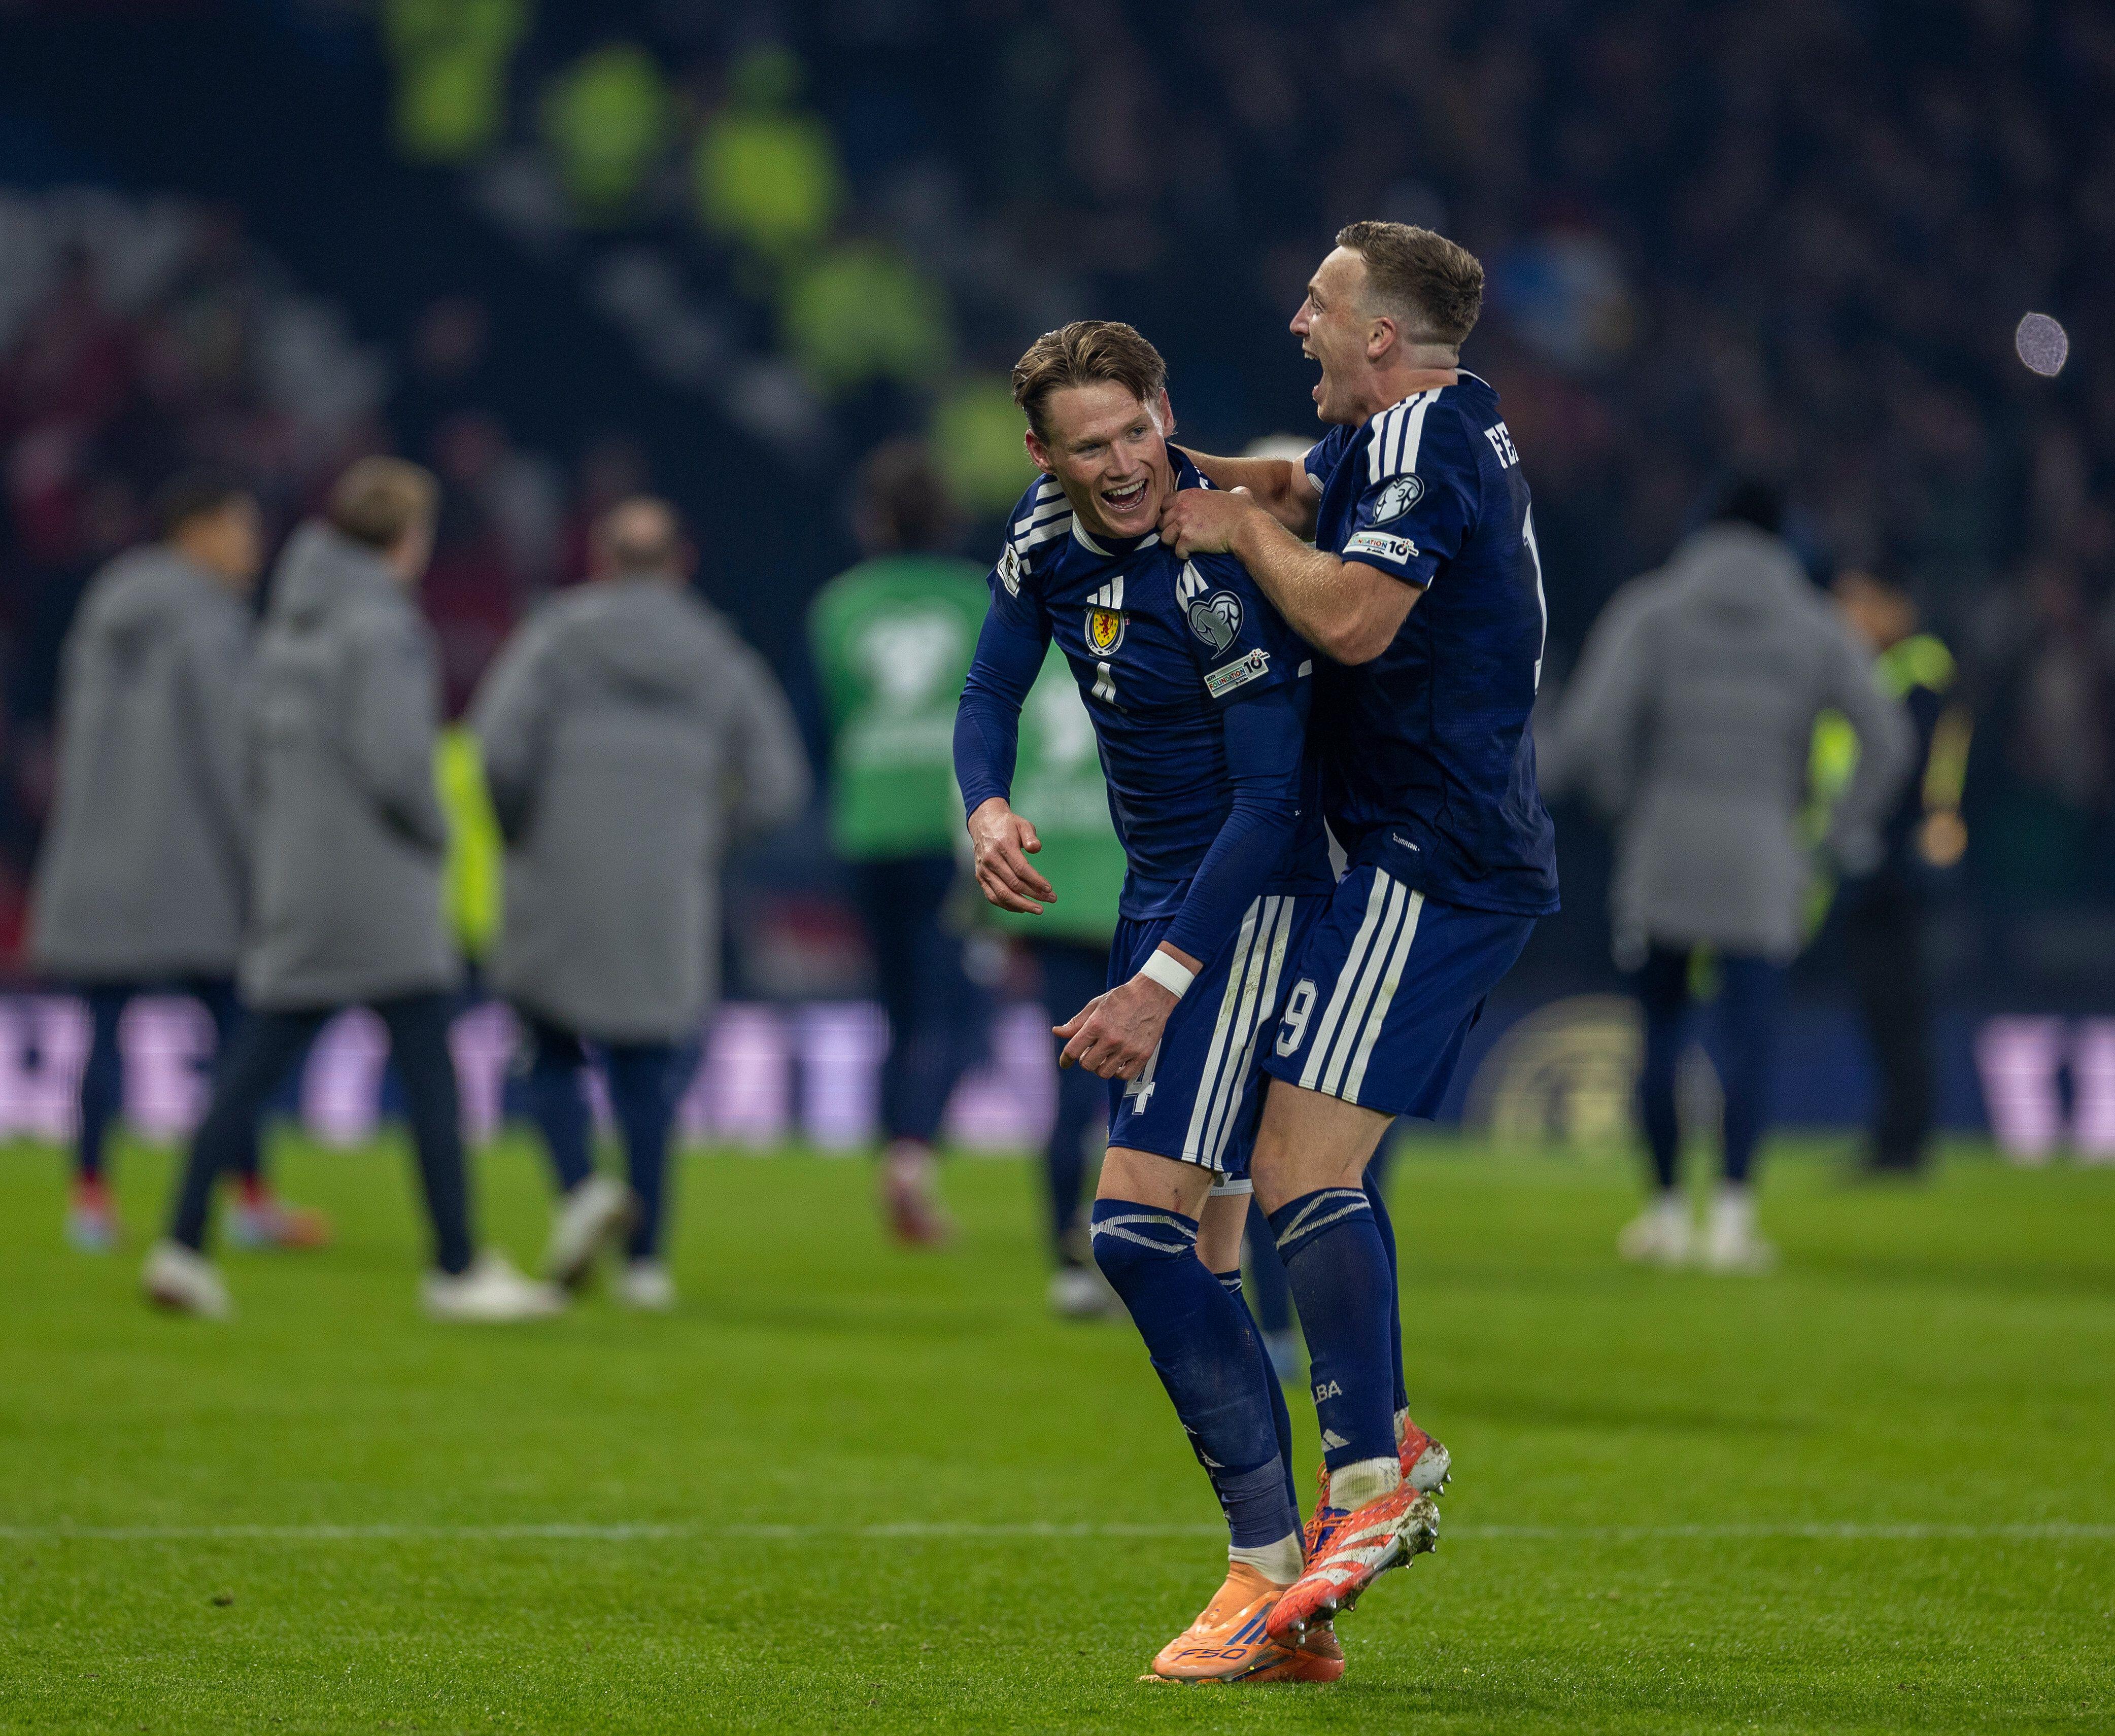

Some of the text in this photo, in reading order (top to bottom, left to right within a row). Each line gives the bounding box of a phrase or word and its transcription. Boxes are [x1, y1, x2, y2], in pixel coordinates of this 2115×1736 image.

[1484, 421, 1519, 469] FE
[1389, 540, 1408, 556] 10
[1243, 657, 1263, 673] 10
[1209, 668, 1246, 690] FOUNDATION
[1277, 978, 1318, 1057] 9
